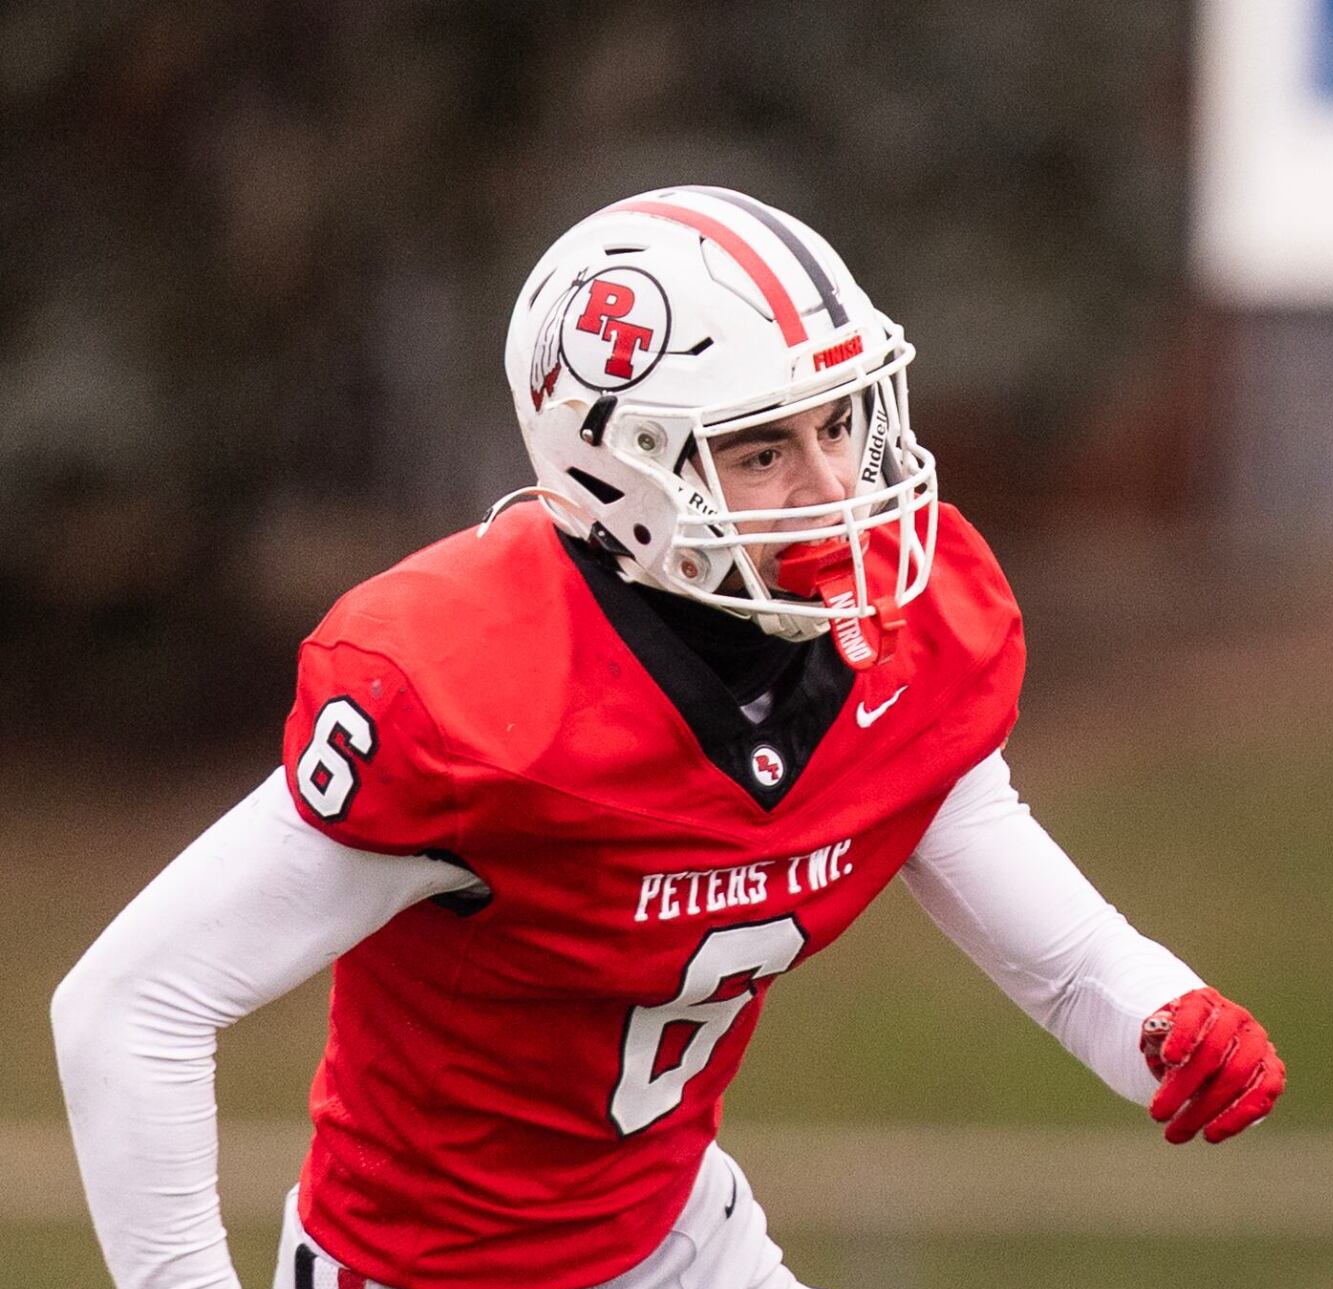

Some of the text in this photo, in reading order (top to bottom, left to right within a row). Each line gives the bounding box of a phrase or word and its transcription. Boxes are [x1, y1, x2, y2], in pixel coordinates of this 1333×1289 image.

[576, 279, 653, 379] PT
[861, 409, 889, 483] Riddell
[828, 590, 873, 663] NTRND
[296, 694, 380, 825] 6
[634, 860, 776, 922] PETERS
[607, 912, 809, 1140] 6
